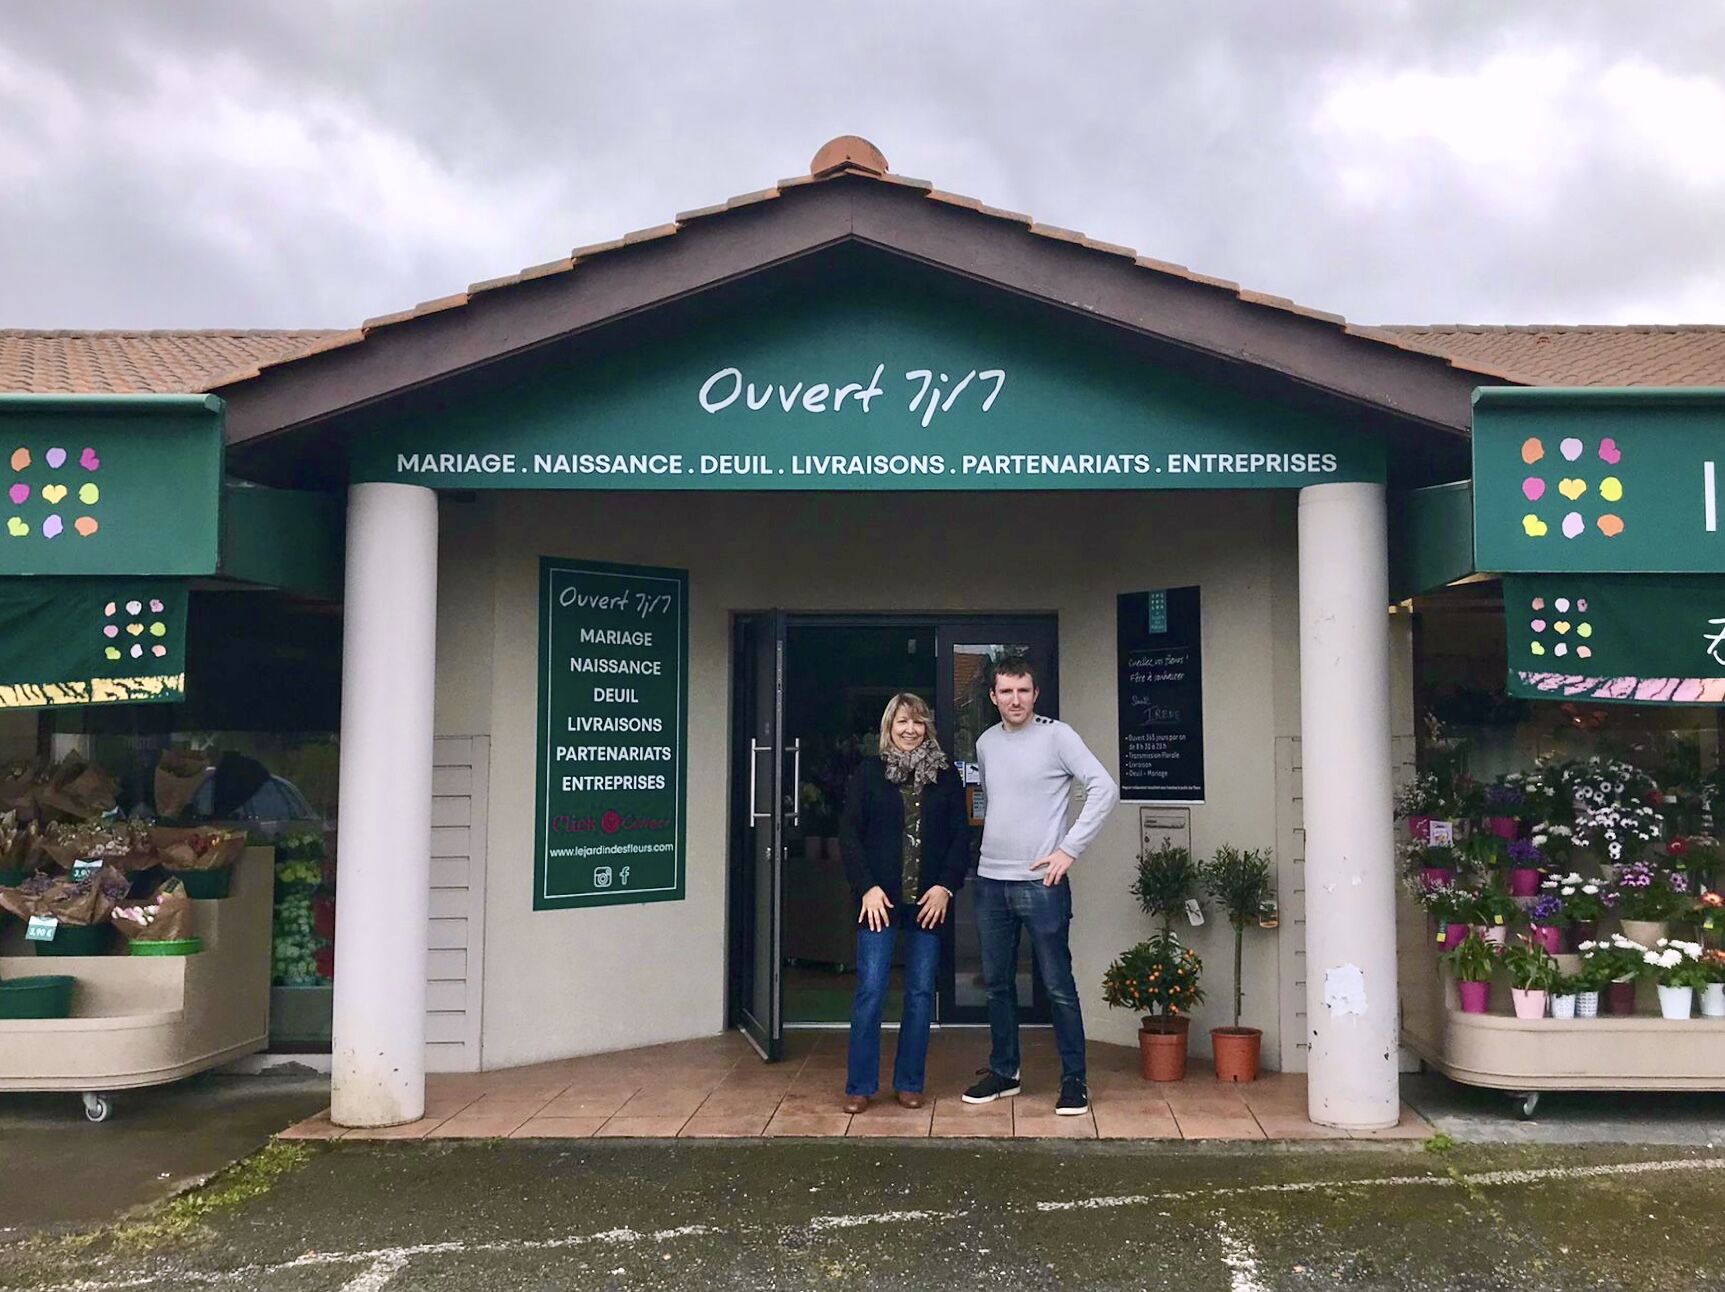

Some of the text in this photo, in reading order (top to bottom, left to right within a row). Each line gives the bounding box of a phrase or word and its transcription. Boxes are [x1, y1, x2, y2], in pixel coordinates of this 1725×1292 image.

[698, 363, 1006, 428] Ouvert 7j/7
[397, 453, 1337, 475] MARIAGE NAISSANCE DEUIL LIVRAISONS PARTENARIATS ENTREPRISES
[559, 586, 672, 619] Ouvert 7j/7
[580, 628, 653, 647] MARIAGE
[570, 657, 661, 676] NAISSANCE
[593, 687, 639, 704] DEUIL
[567, 716, 663, 733] LIVRAISONS
[556, 745, 672, 762] PARTENARIATS
[562, 774, 666, 792] ENTREPRISES
[549, 843, 674, 859] www.lejardindesfleurs.com
